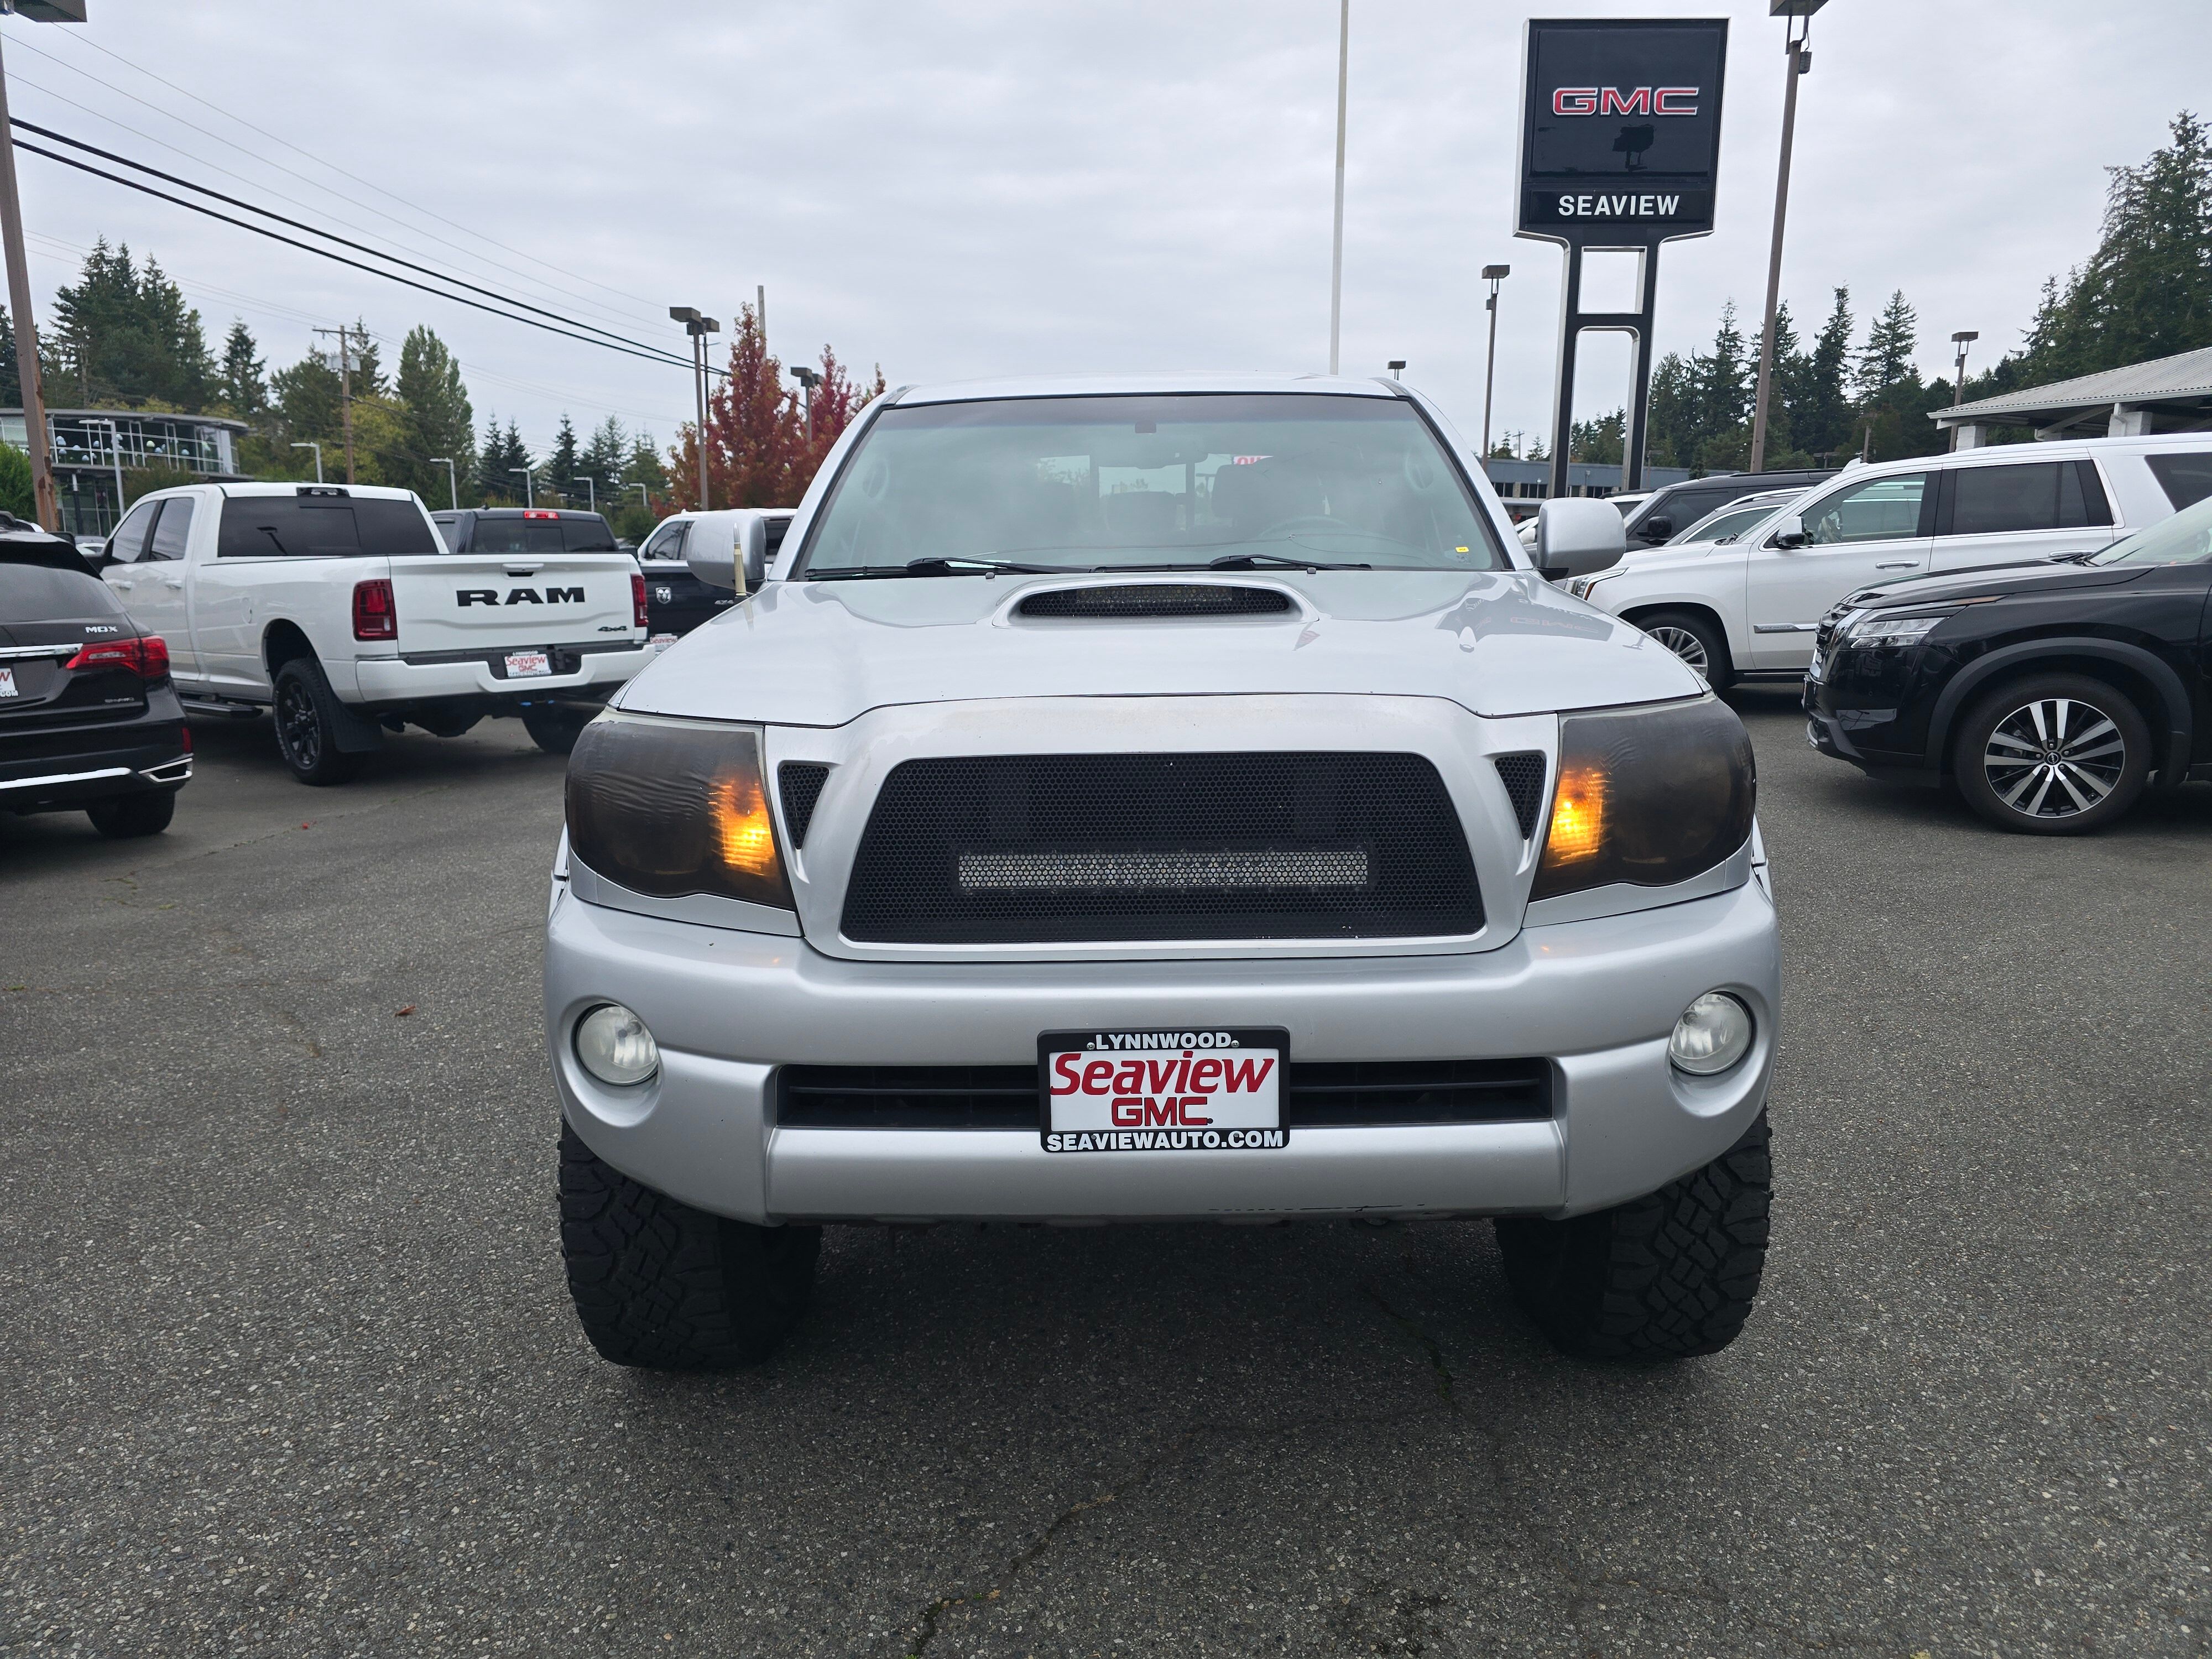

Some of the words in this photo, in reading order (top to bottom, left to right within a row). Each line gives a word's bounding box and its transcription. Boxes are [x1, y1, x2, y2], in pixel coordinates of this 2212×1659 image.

[1552, 87, 1699, 116] GMC
[1558, 195, 1679, 216] SEAVIEW
[456, 587, 585, 607] RAM
[505, 655, 546, 666] Seaview
[1095, 1032, 1232, 1050] LYNNWOOD
[1051, 1051, 1275, 1095] Seaview
[1111, 1096, 1208, 1126] GMC
[1047, 1130, 1283, 1151] SEAVIEWAUTO.COM
